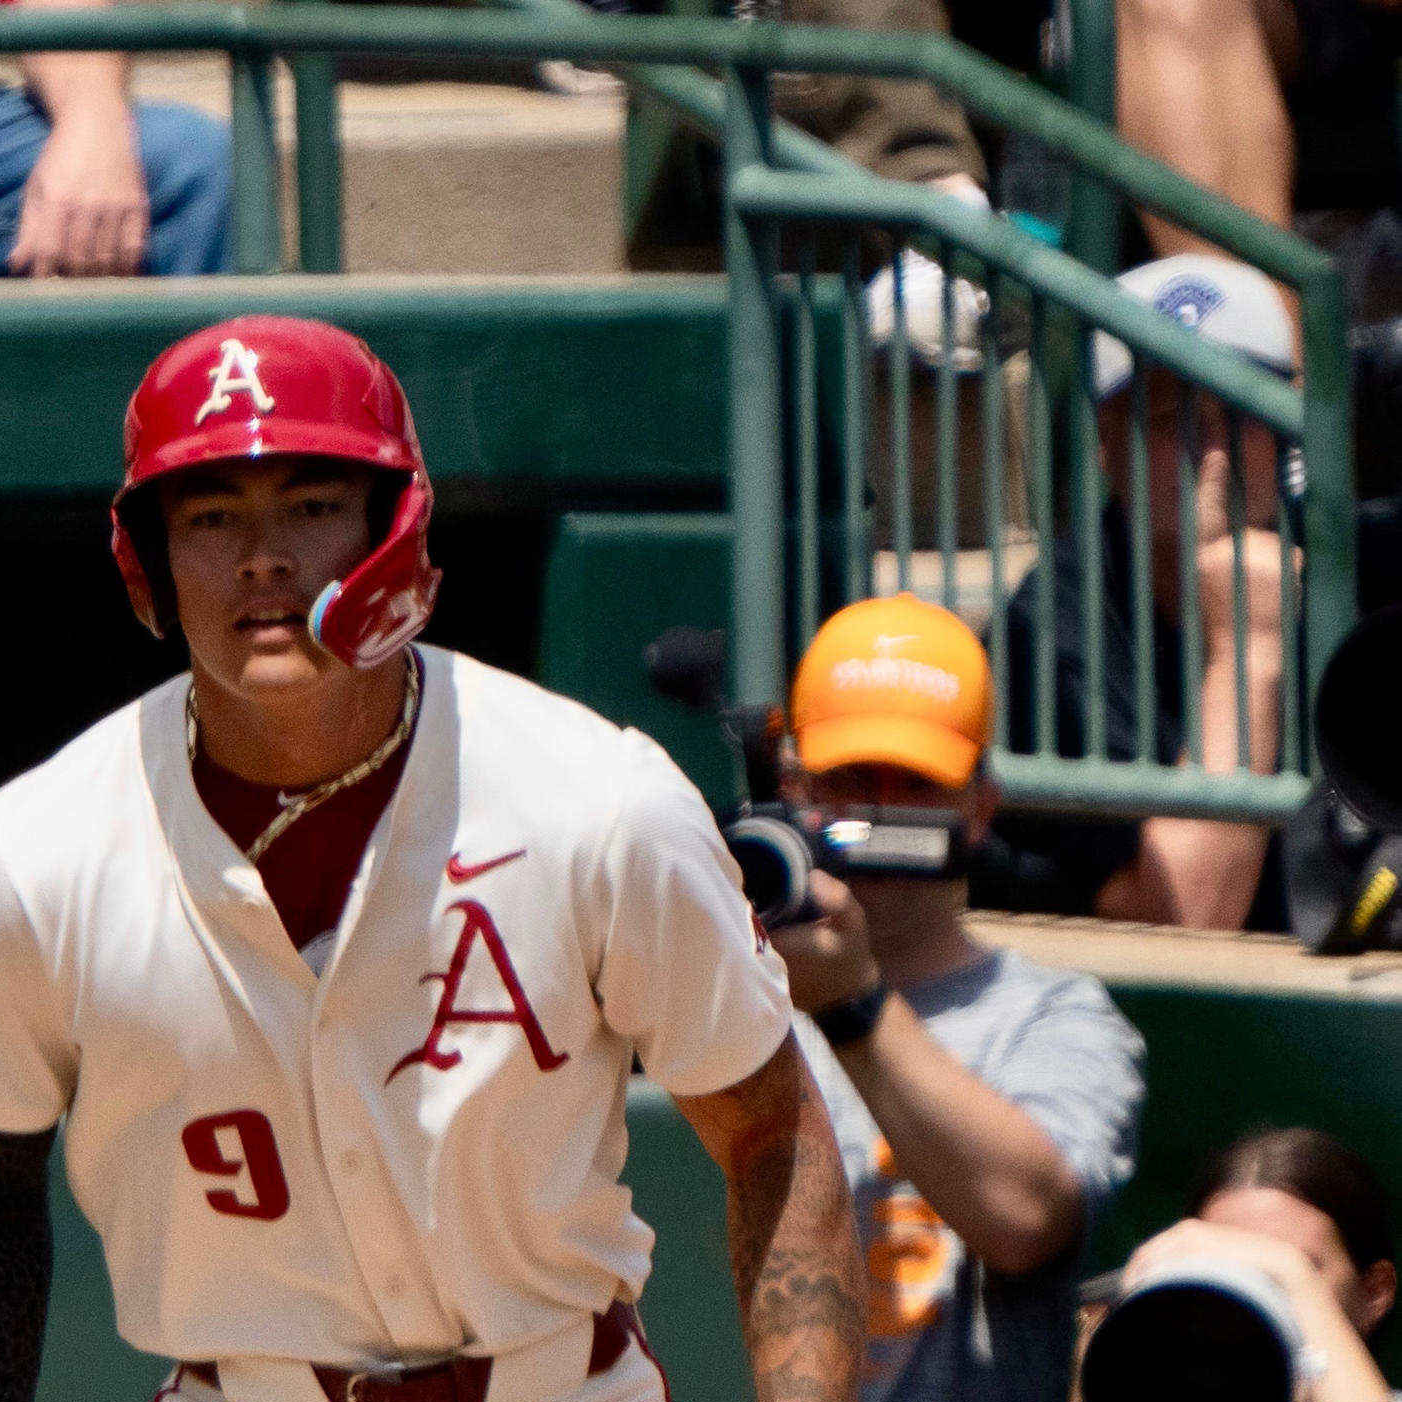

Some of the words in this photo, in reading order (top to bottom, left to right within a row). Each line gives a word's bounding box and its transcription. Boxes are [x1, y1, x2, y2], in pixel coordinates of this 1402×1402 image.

[194, 338, 276, 427] A
[383, 897, 572, 1090] A
[181, 1107, 291, 1222] 9
